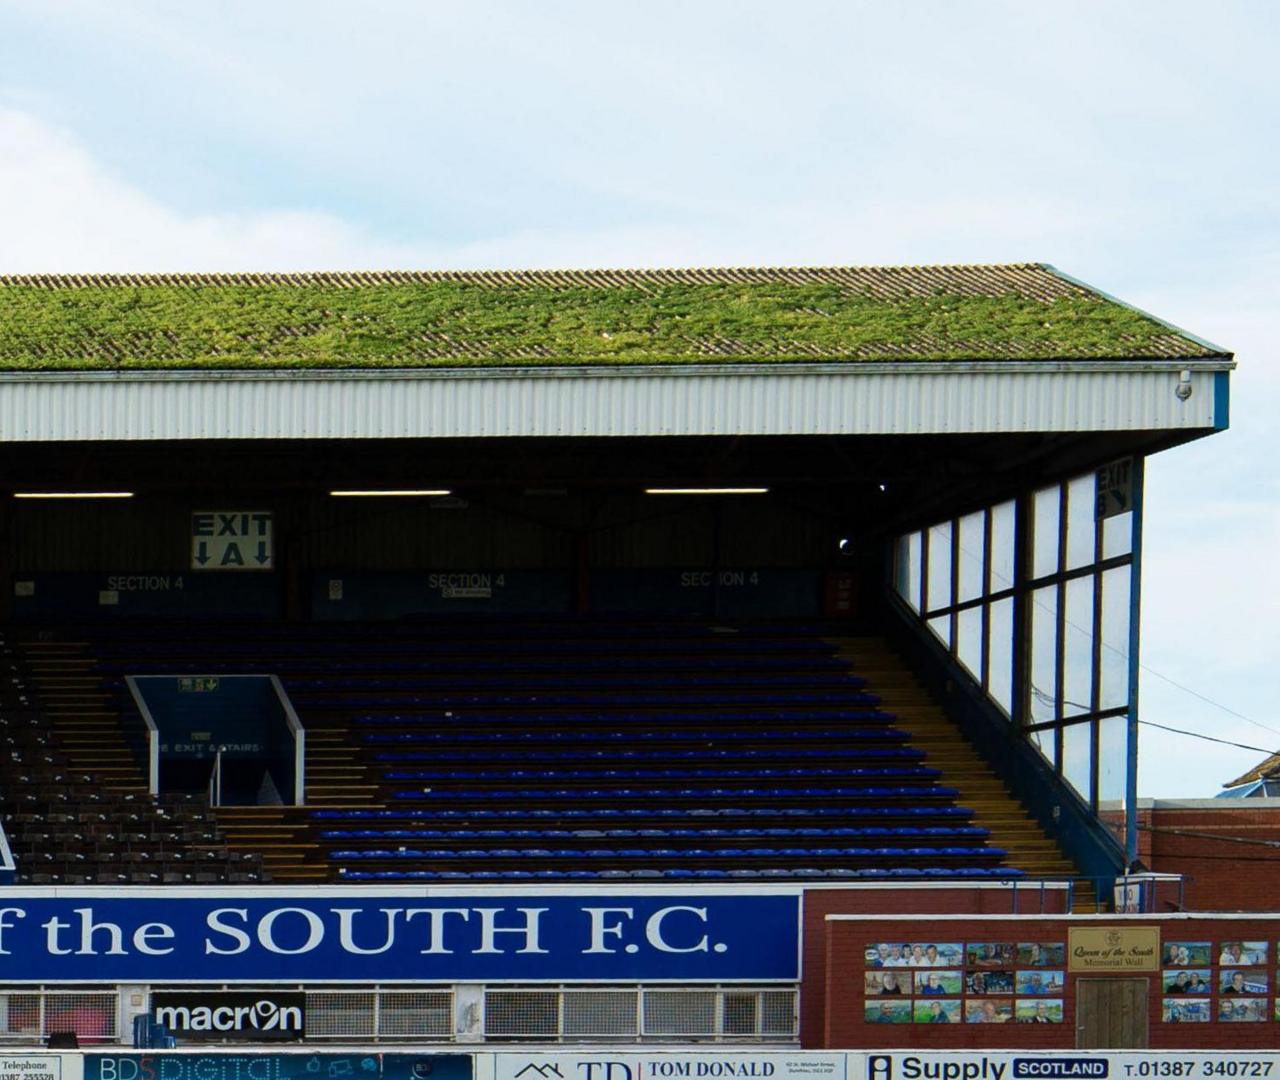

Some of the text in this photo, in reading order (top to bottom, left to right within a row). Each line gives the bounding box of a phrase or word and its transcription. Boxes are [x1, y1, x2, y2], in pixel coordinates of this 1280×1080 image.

[193, 514, 272, 536] EXIT
[221, 542, 245, 566] A
[107, 576, 184, 591] SECTION 4
[429, 573, 505, 589] SECTION 4
[681, 571, 758, 587] SECION 4
[42, 907, 175, 957] the
[205, 906, 550, 956] SOUTH
[581, 906, 728, 956] F.C.
[1084, 958, 1143, 967] Memorial Wall
[156, 1001, 302, 1031] macron
[3, 1061, 47, 1071] Telephone
[648, 1062, 775, 1077] TOM DONALD
[1018, 1063, 1105, 1075] SCOTLAND
[1202, 1061, 1274, 1076] 340727
